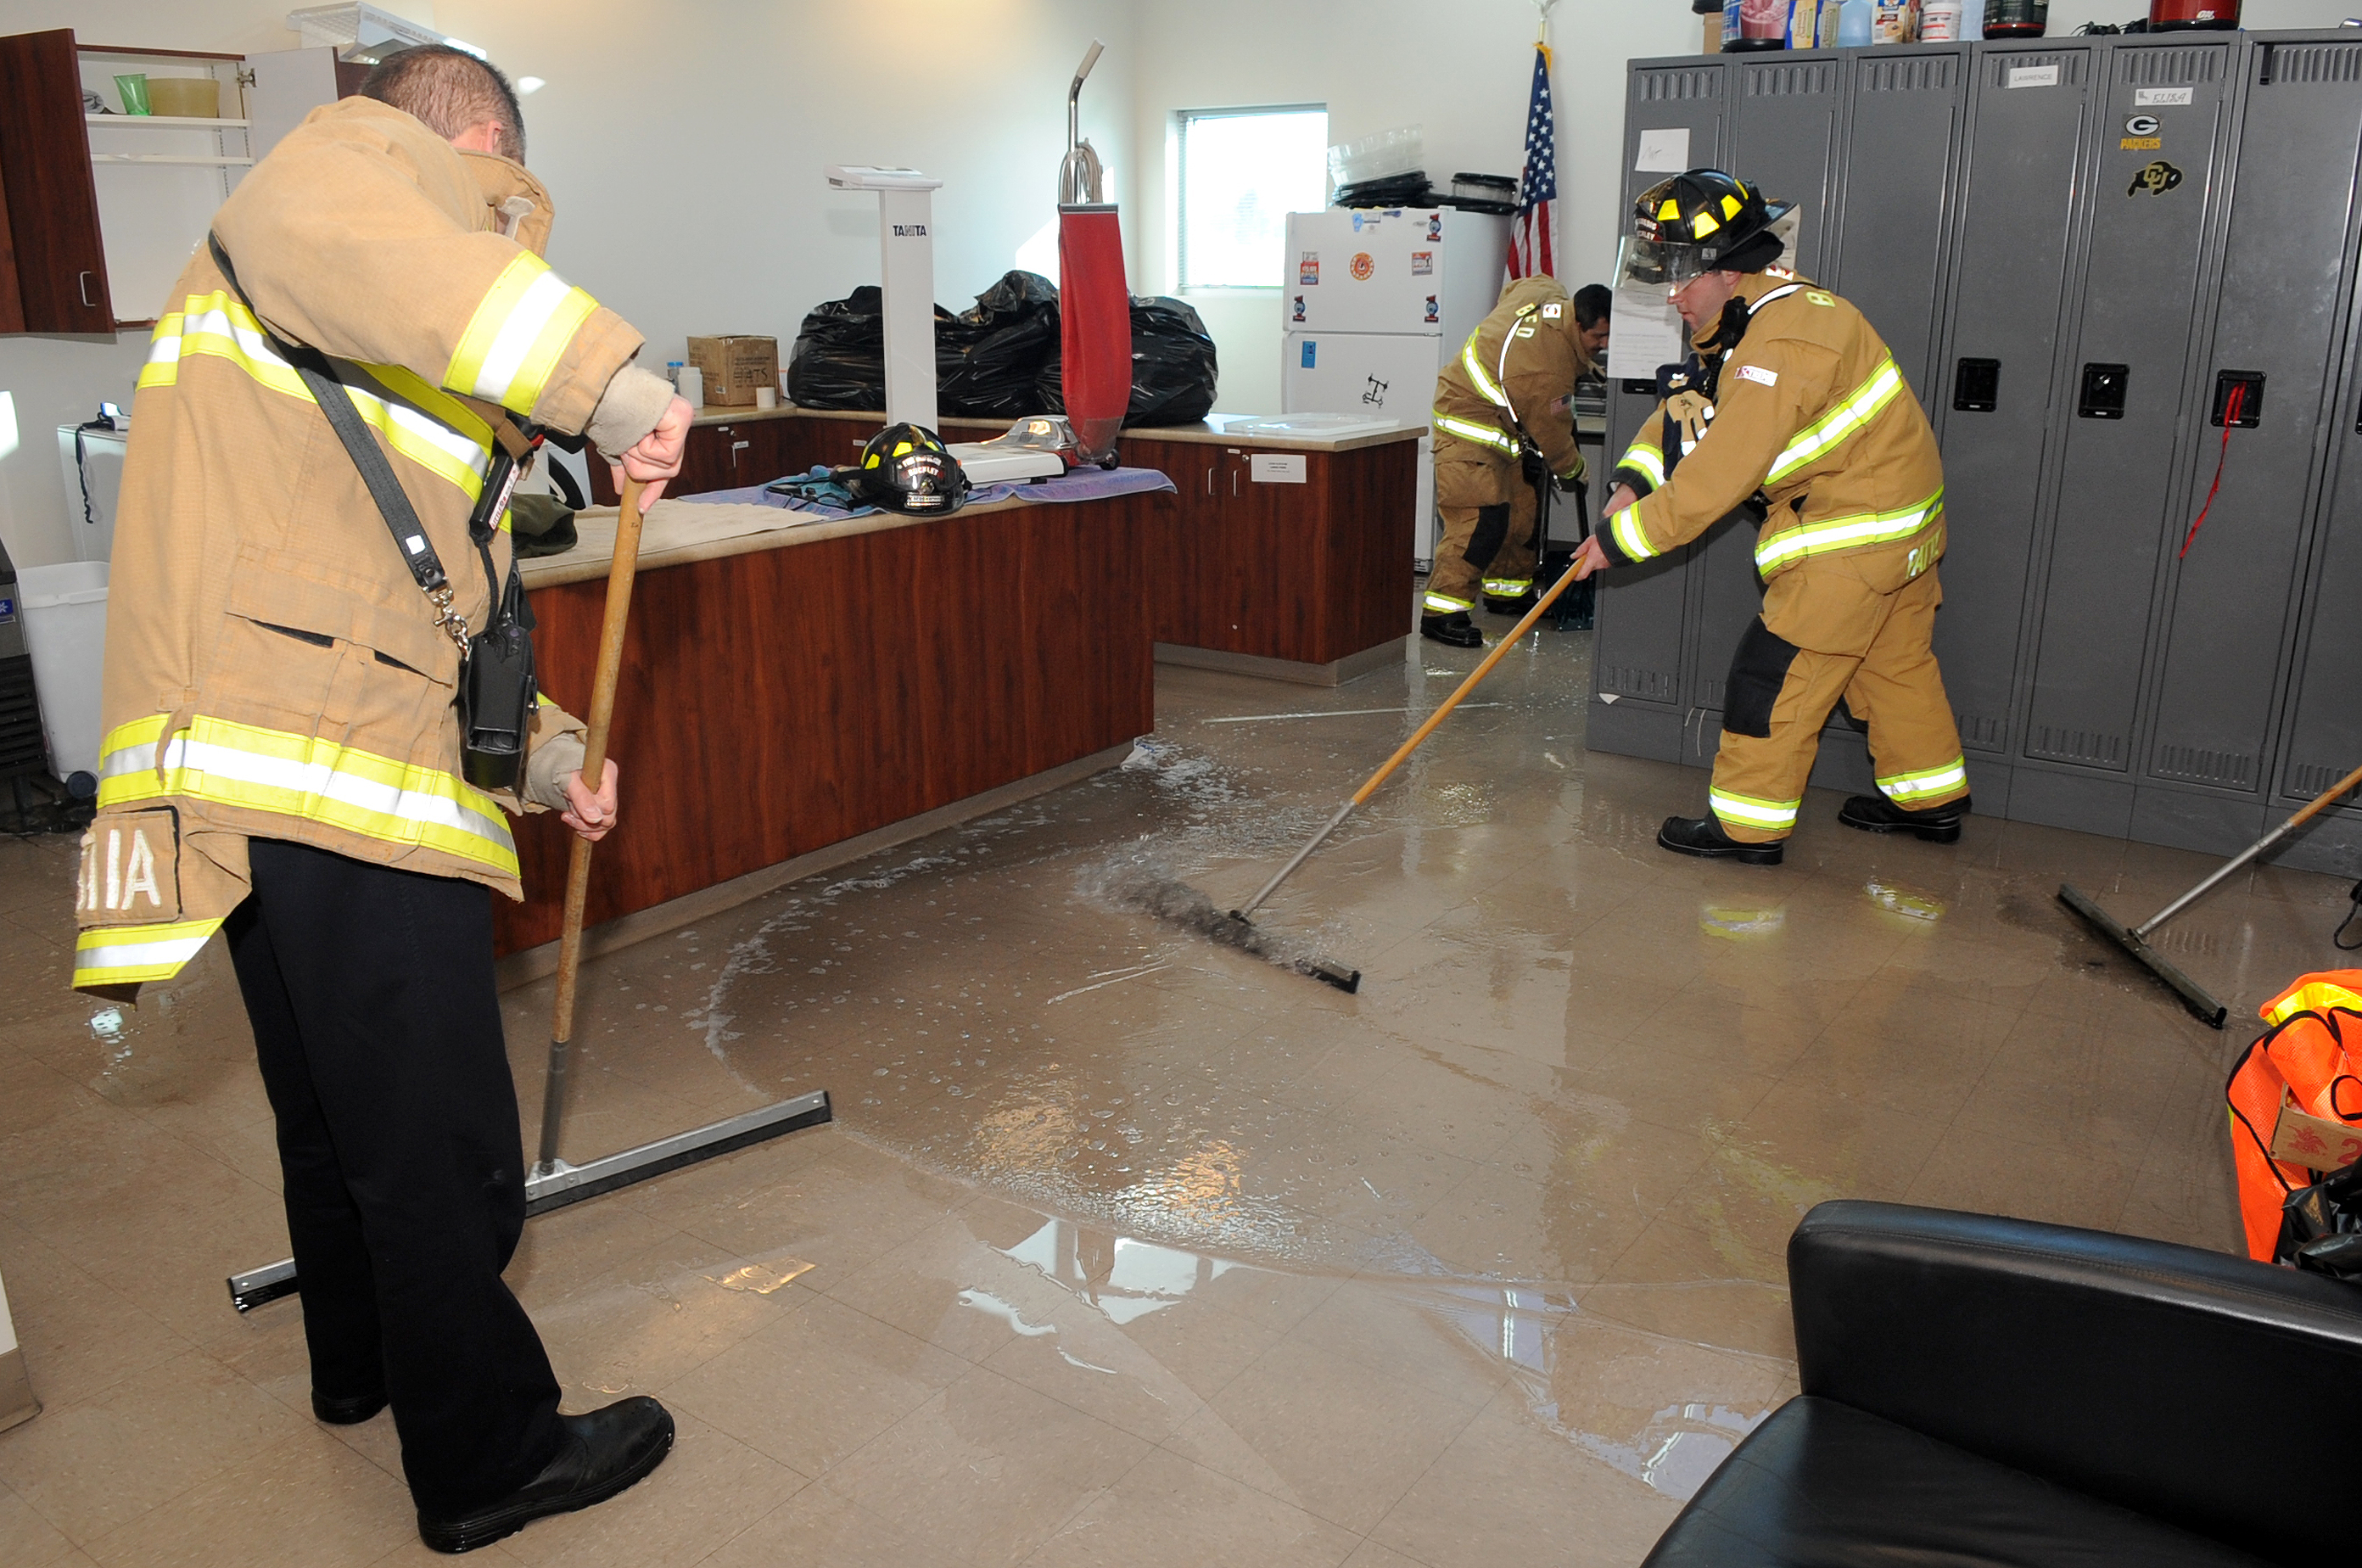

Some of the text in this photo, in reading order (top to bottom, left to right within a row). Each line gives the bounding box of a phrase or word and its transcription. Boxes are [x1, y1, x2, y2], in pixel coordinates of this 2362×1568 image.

[2013, 73, 2052, 82] LAWRENCE
[2120, 137, 2162, 150] PACKERS
[893, 224, 927, 237] TANITA
